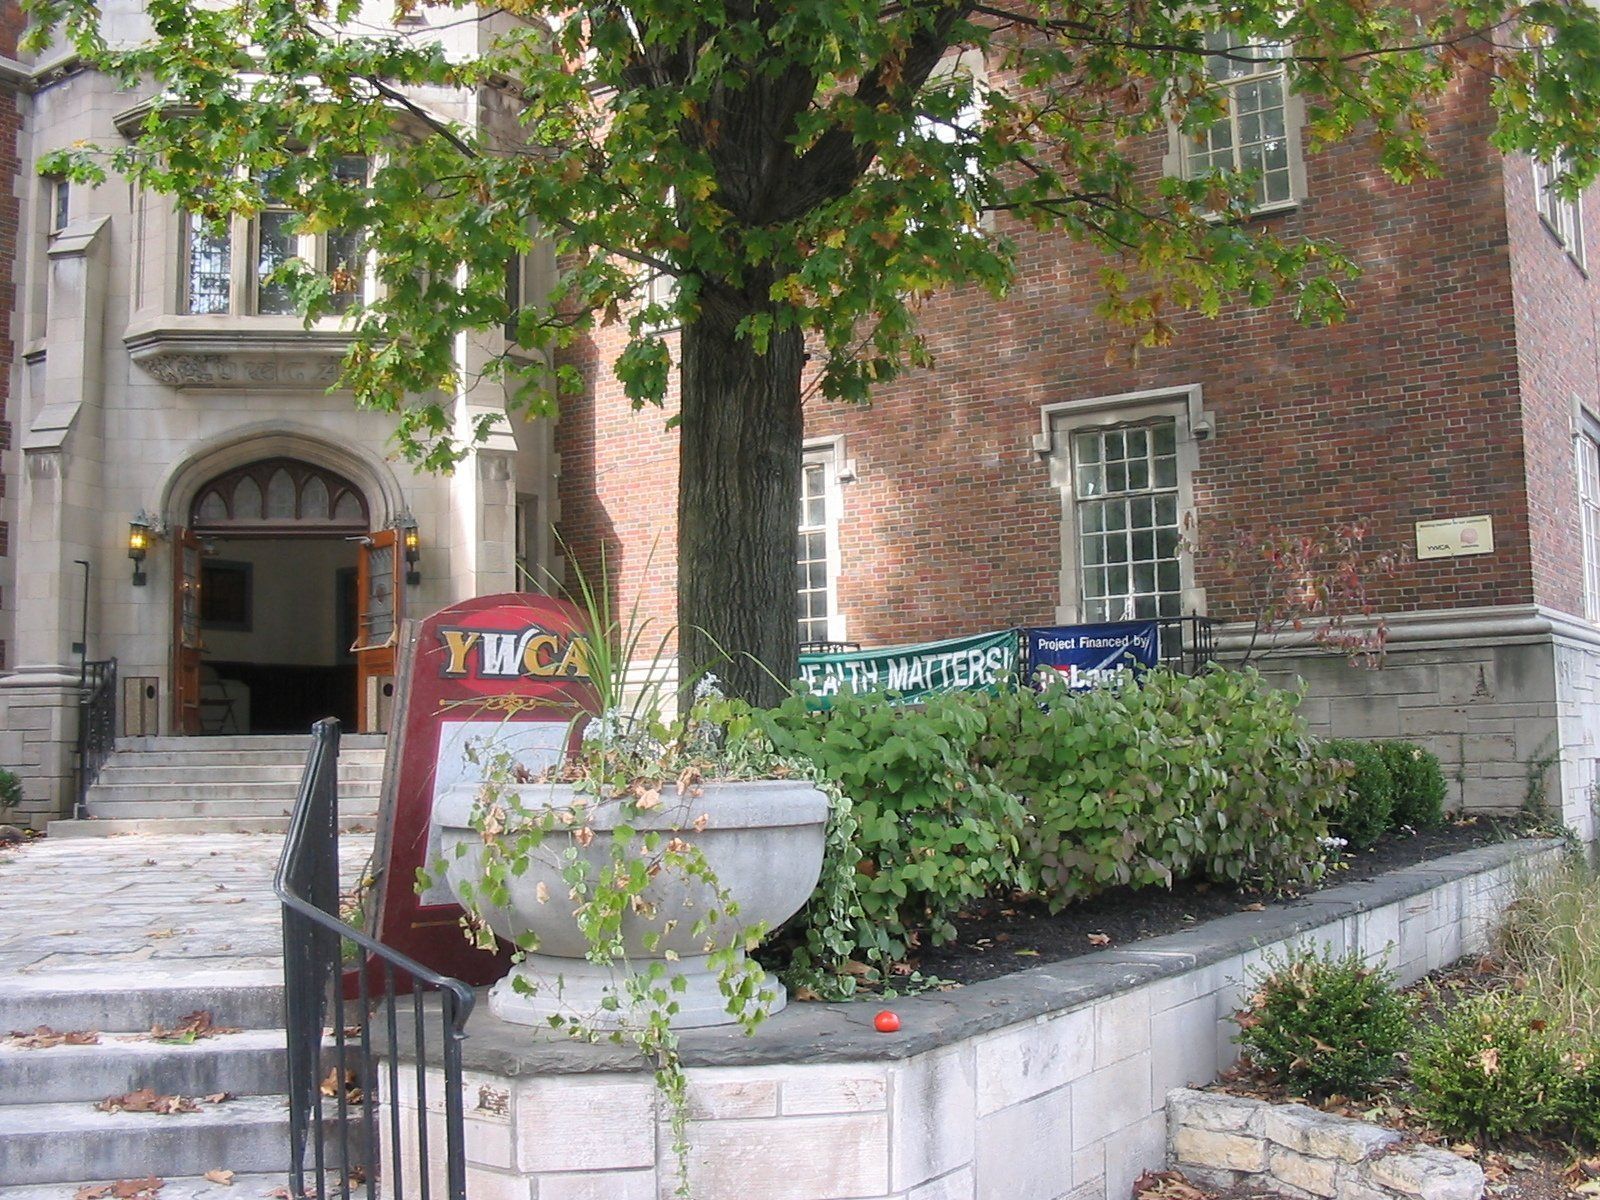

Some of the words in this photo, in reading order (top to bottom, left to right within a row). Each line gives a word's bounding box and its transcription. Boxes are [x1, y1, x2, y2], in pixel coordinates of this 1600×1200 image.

[442, 628, 590, 676] YWCA
[1038, 638, 1075, 651] Project
[1080, 635, 1129, 648] Financed
[1133, 635, 1147, 649] by
